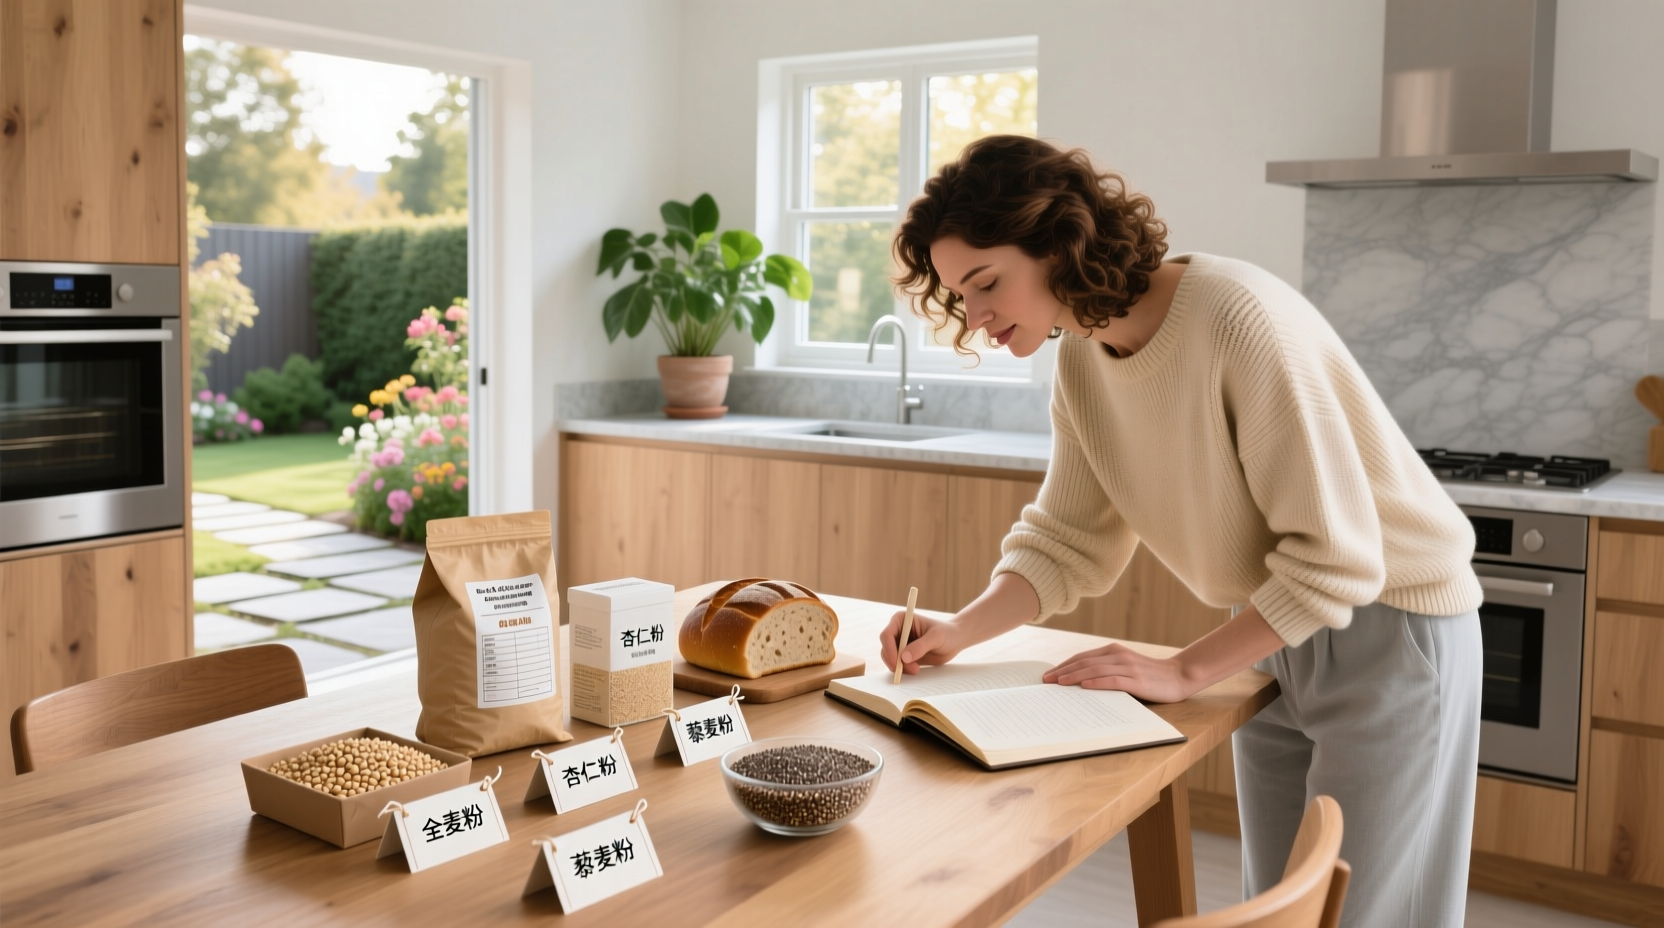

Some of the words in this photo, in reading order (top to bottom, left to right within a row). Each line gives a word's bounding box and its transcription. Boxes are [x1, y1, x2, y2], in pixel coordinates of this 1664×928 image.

[620, 623, 664, 648] 杏仁粉
[561, 753, 617, 789] 杏仁粉
[422, 803, 483, 843] 全麦粉
